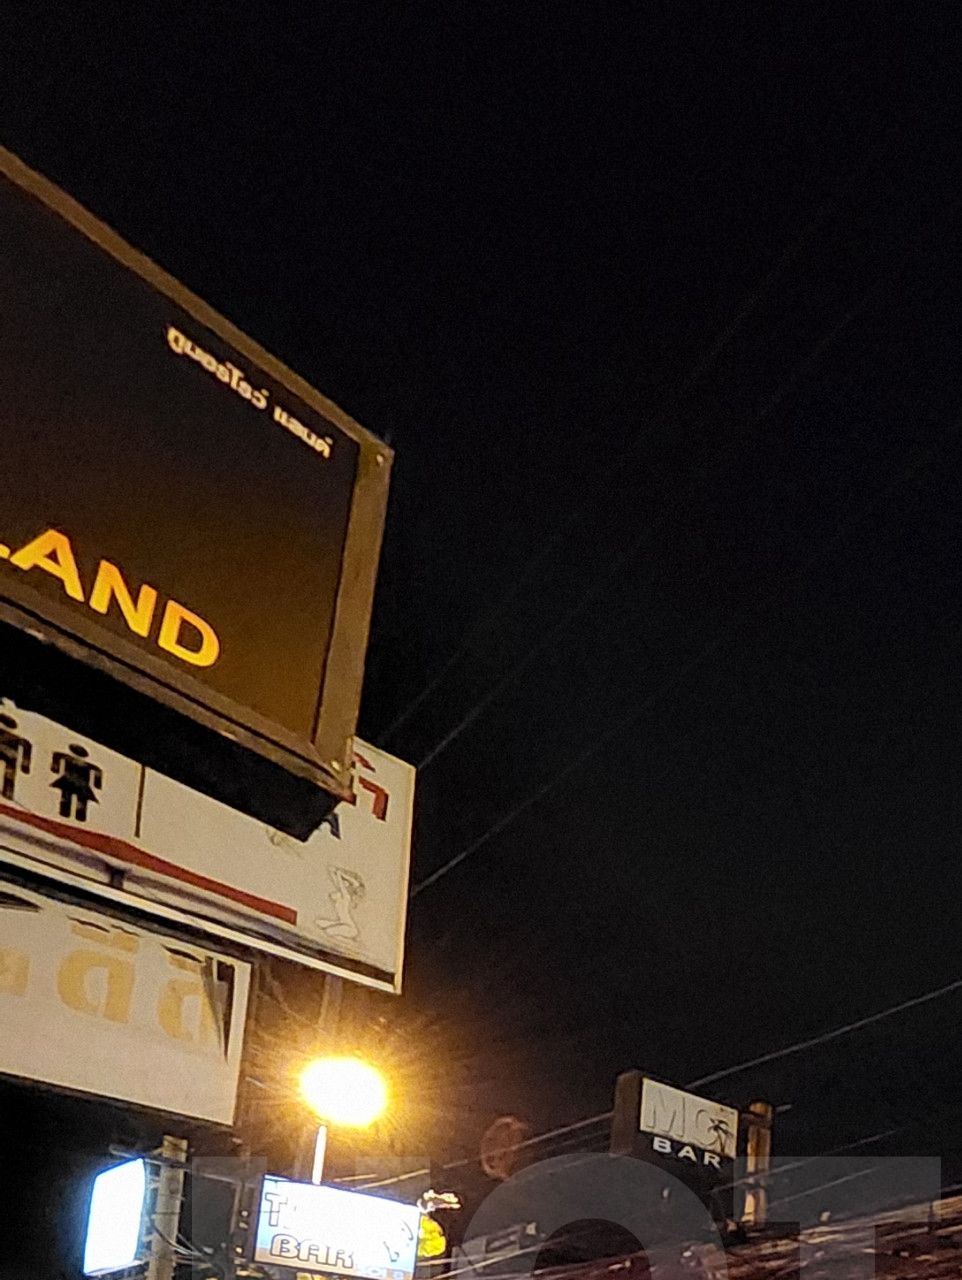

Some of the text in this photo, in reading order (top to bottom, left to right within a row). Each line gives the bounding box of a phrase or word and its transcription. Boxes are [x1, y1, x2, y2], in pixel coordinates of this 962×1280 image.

[0, 529, 220, 667] AND
[653, 1137, 721, 1169] BAR
[271, 1234, 354, 1269] BAR
